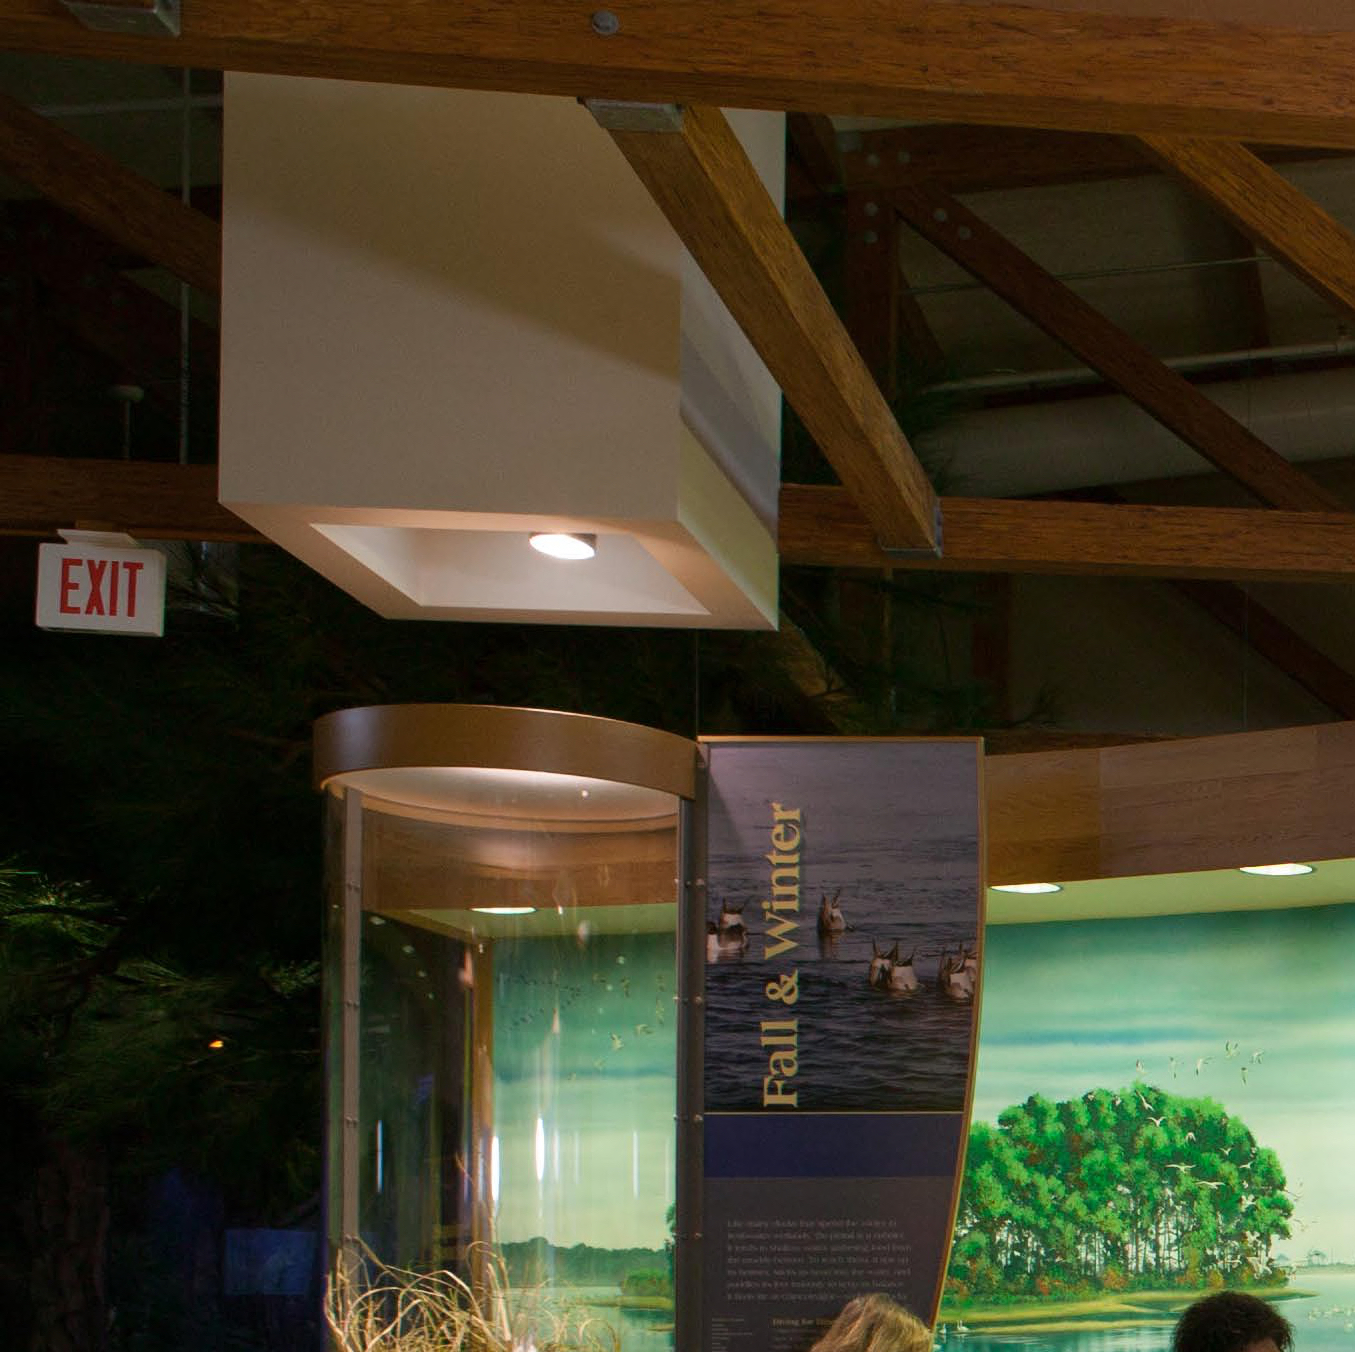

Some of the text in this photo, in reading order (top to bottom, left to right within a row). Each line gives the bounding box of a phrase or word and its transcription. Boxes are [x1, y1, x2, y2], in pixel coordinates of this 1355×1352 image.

[59, 558, 144, 618] EXIT
[760, 801, 801, 1108] Fall & Winter
